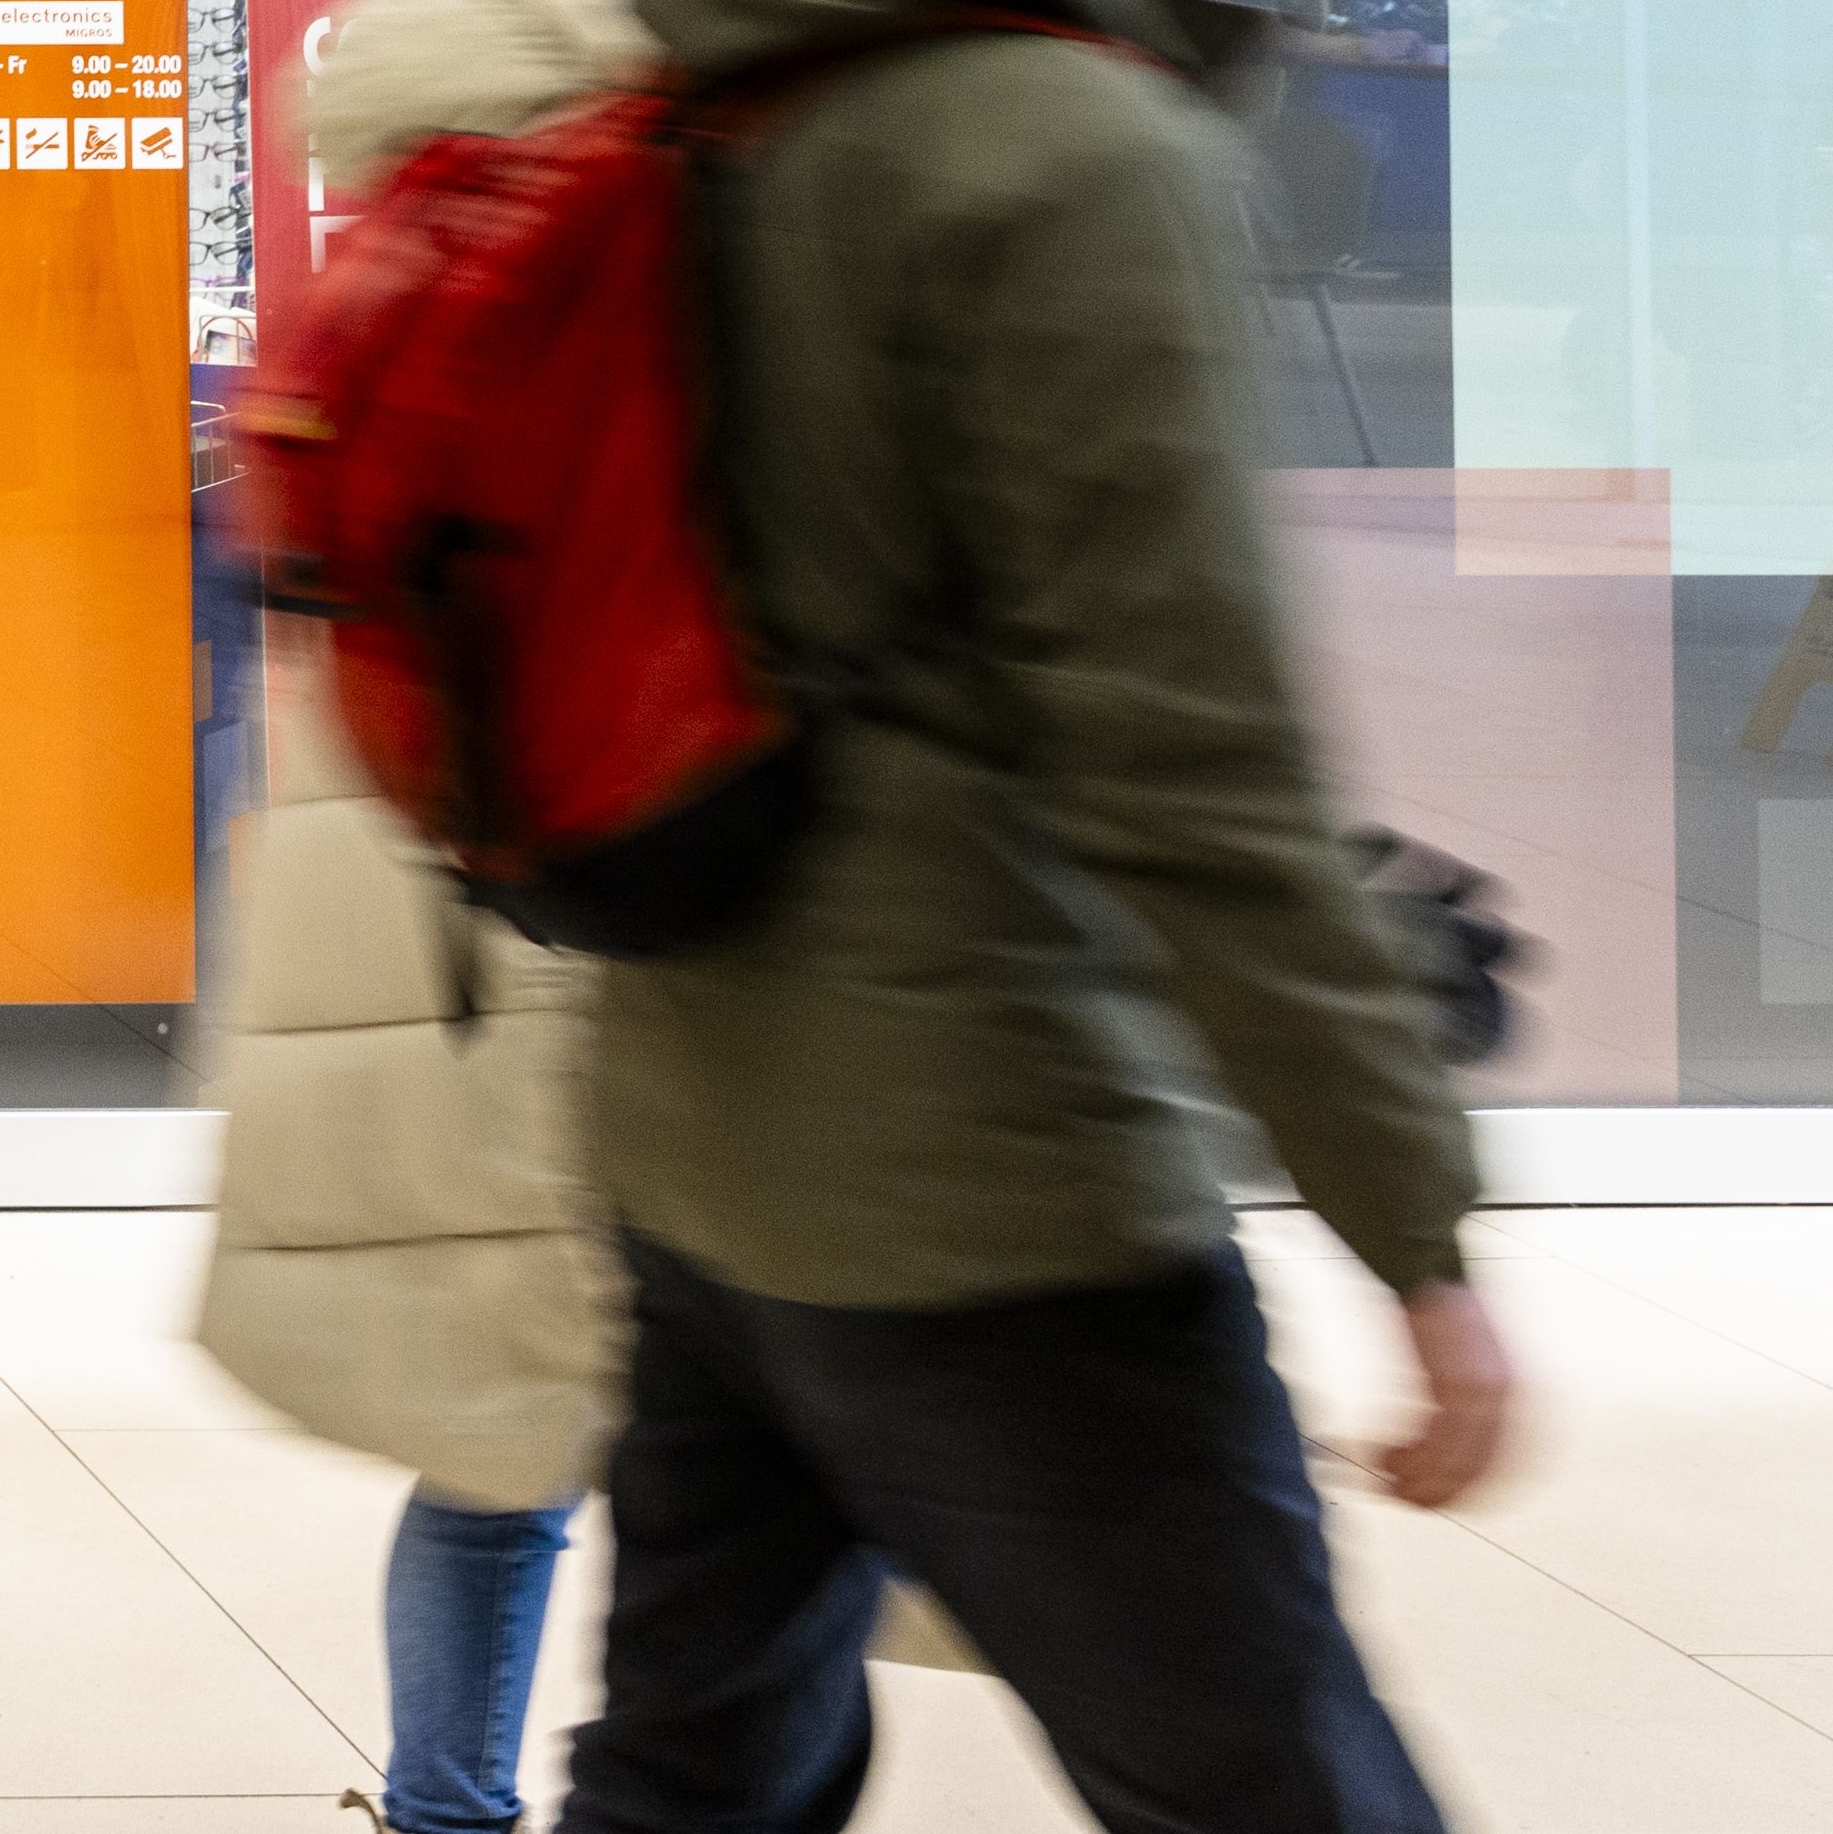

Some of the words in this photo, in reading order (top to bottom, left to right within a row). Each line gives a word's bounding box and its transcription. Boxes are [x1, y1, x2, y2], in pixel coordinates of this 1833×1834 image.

[1, 7, 113, 24] electronics
[65, 28, 113, 38] MIGROS
[8, 55, 28, 75] Fr
[71, 55, 111, 75] 9.00
[131, 55, 182, 75] 20.00
[71, 80, 112, 99] 9.00
[132, 80, 183, 99] 18.00
